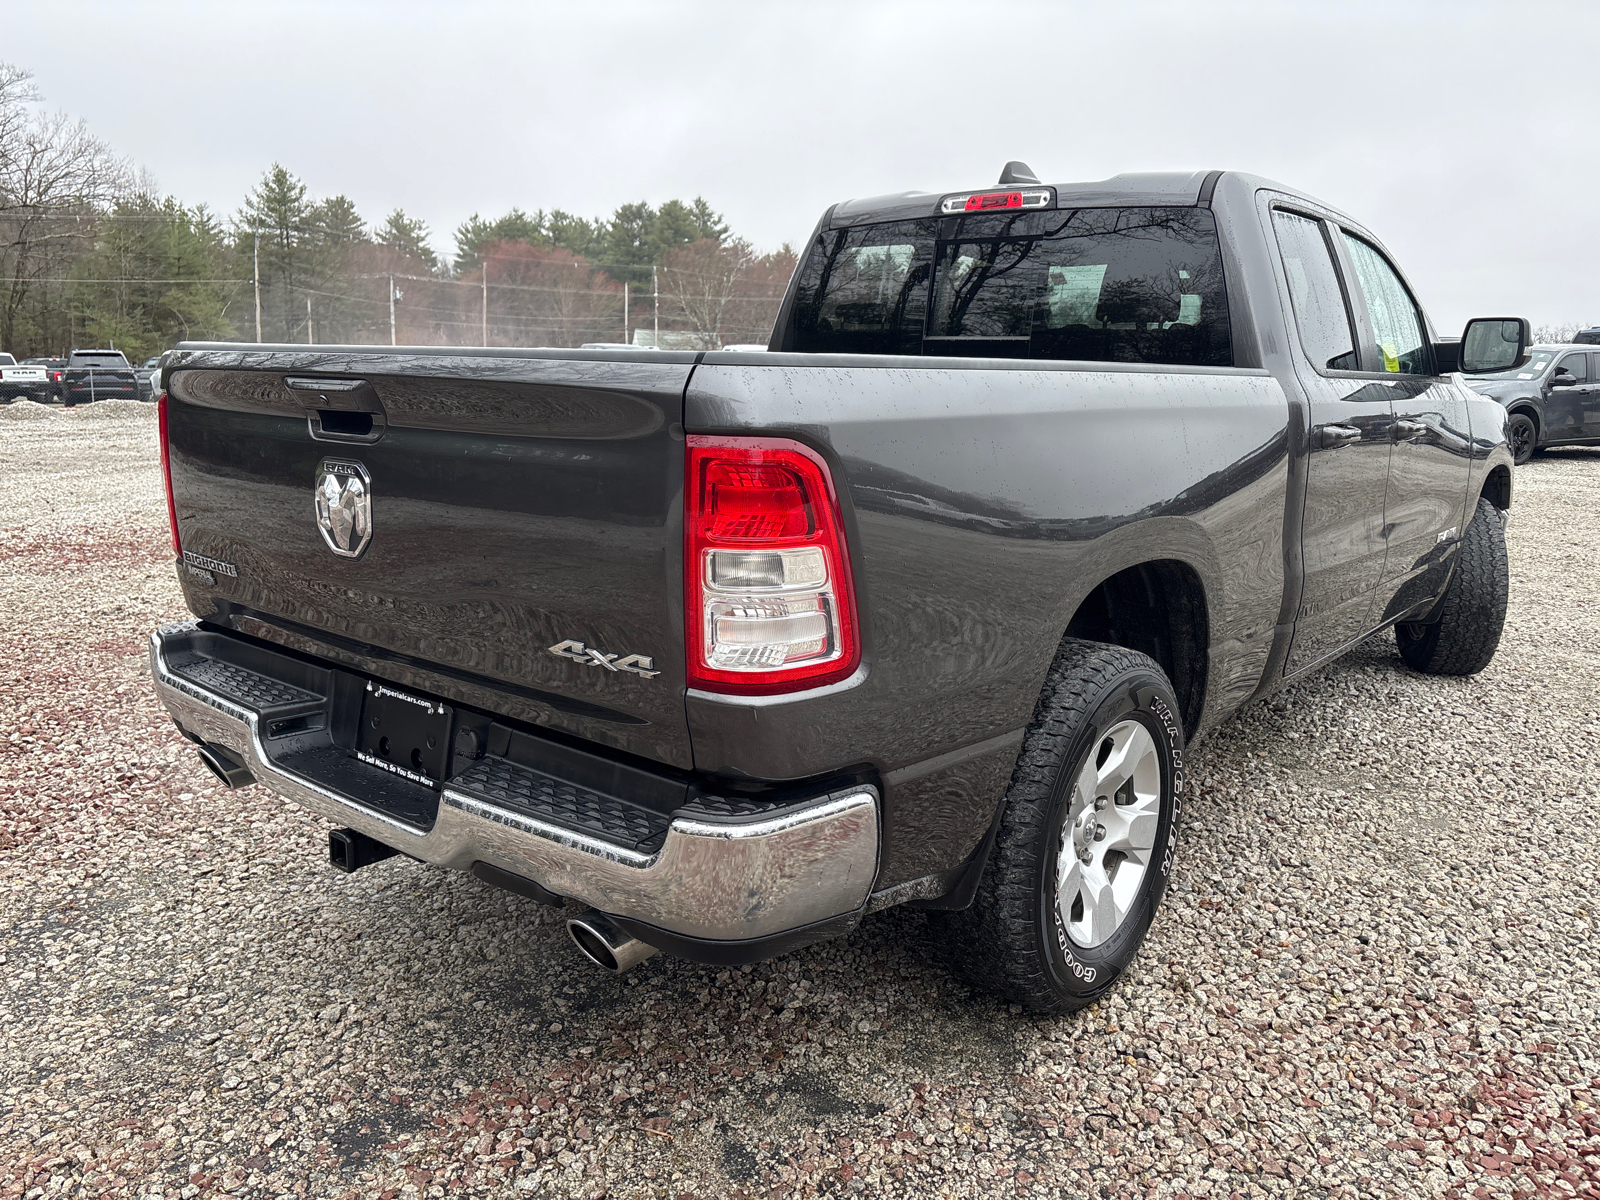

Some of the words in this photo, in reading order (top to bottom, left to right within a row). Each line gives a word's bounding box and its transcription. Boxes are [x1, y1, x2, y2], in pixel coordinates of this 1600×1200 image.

[323, 462, 356, 475] RAM
[183, 550, 238, 577] BIGHORN
[357, 752, 365, 761] We
[365, 755, 375, 764] Sell
[374, 758, 389, 770] More,
[389, 764, 396, 773] So
[396, 766, 407, 776] You
[407, 771, 420, 782] Save
[419, 775, 434, 787] More
[1149, 695, 1183, 877] WRANGLER
